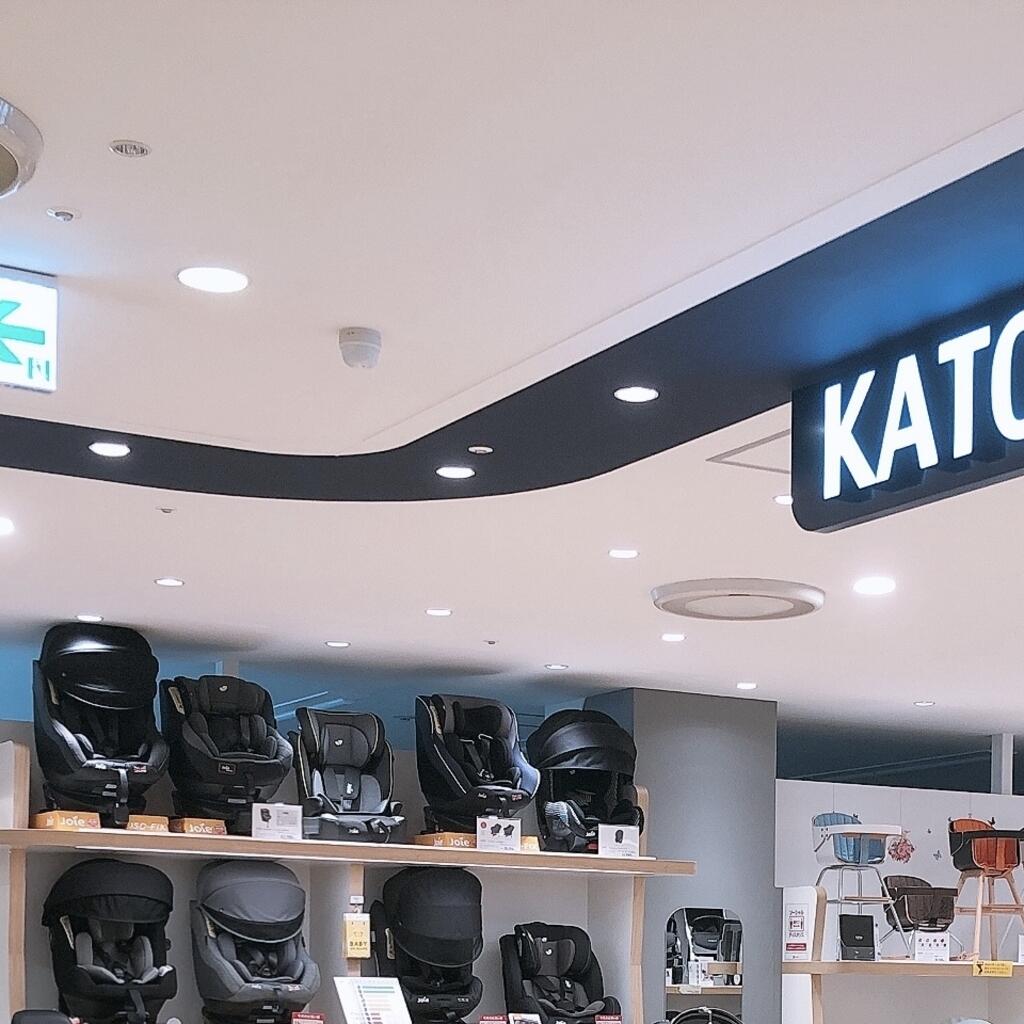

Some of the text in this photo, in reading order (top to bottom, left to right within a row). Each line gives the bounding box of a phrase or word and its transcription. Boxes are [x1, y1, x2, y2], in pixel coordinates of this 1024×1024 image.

[60, 815, 86, 827] Joie
[189, 822, 213, 834] Joie
[449, 836, 470, 847] Joie
